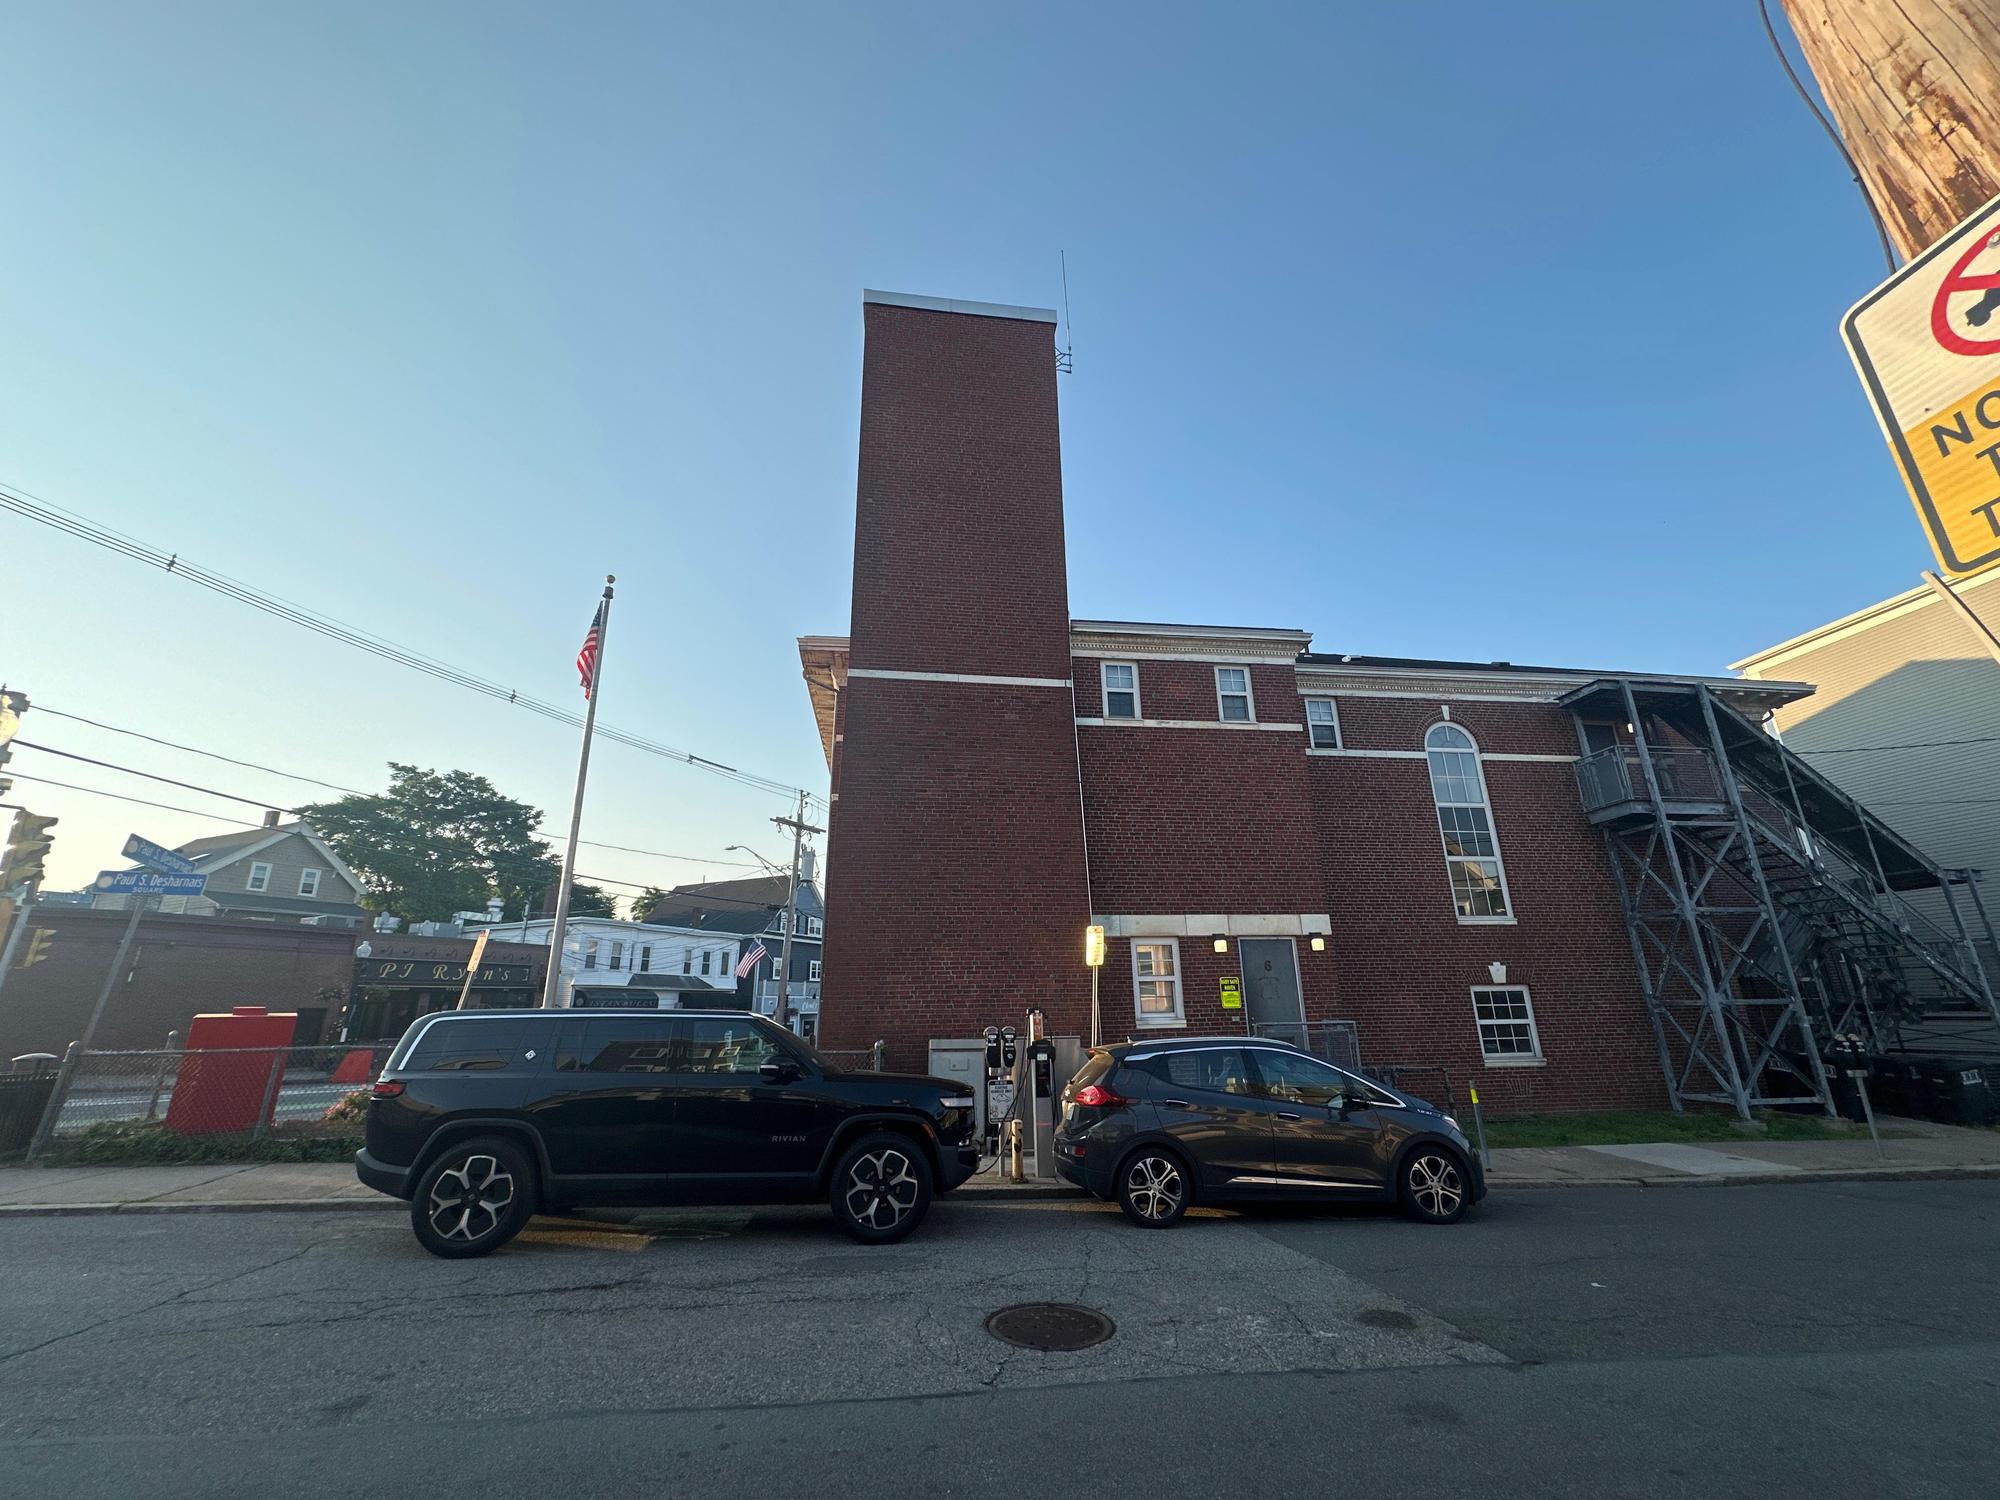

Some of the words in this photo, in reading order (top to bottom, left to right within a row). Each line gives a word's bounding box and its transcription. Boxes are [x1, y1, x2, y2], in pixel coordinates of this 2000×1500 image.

[113, 873, 138, 886] Paul
[138, 874, 147, 886] S.
[150, 873, 204, 888] Desharnais
[131, 886, 164, 894] SQUARE
[379, 962, 414, 979] PJ
[432, 963, 511, 981] Ryn's
[1264, 960, 1273, 972] 6
[771, 1135, 807, 1143] RIVIAN
